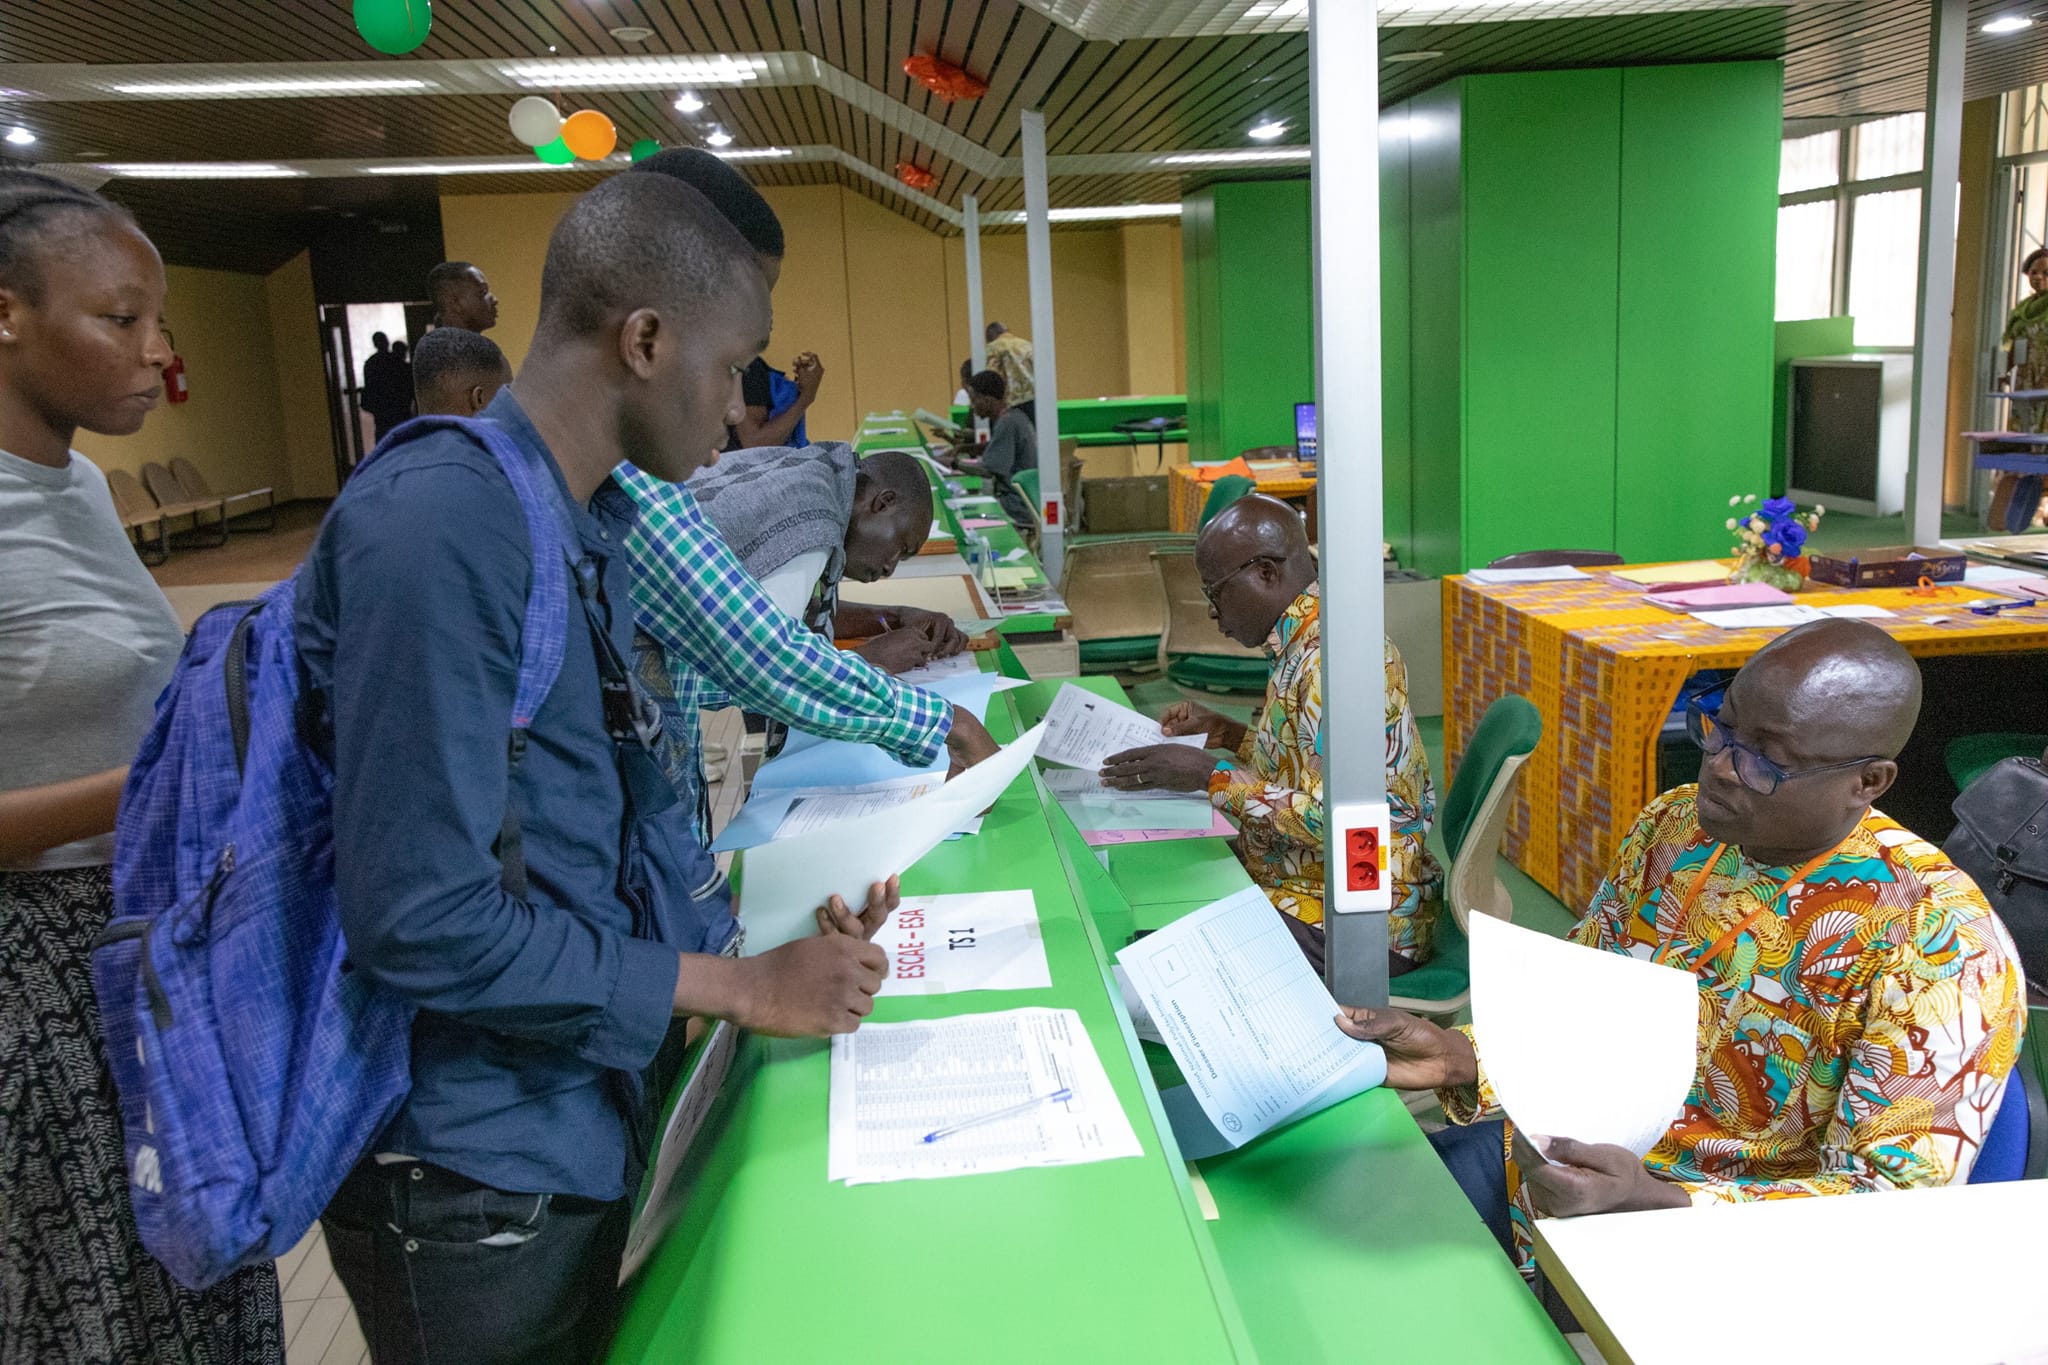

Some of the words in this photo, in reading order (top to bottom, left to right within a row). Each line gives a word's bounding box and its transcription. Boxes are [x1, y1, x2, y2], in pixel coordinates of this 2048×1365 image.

[899, 908, 925, 929] ESA
[948, 936, 976, 950] TS
[897, 941, 925, 979] ESCAE
[1170, 998, 1201, 1049] d'inscription
[1196, 1047, 1218, 1080] Dossier
